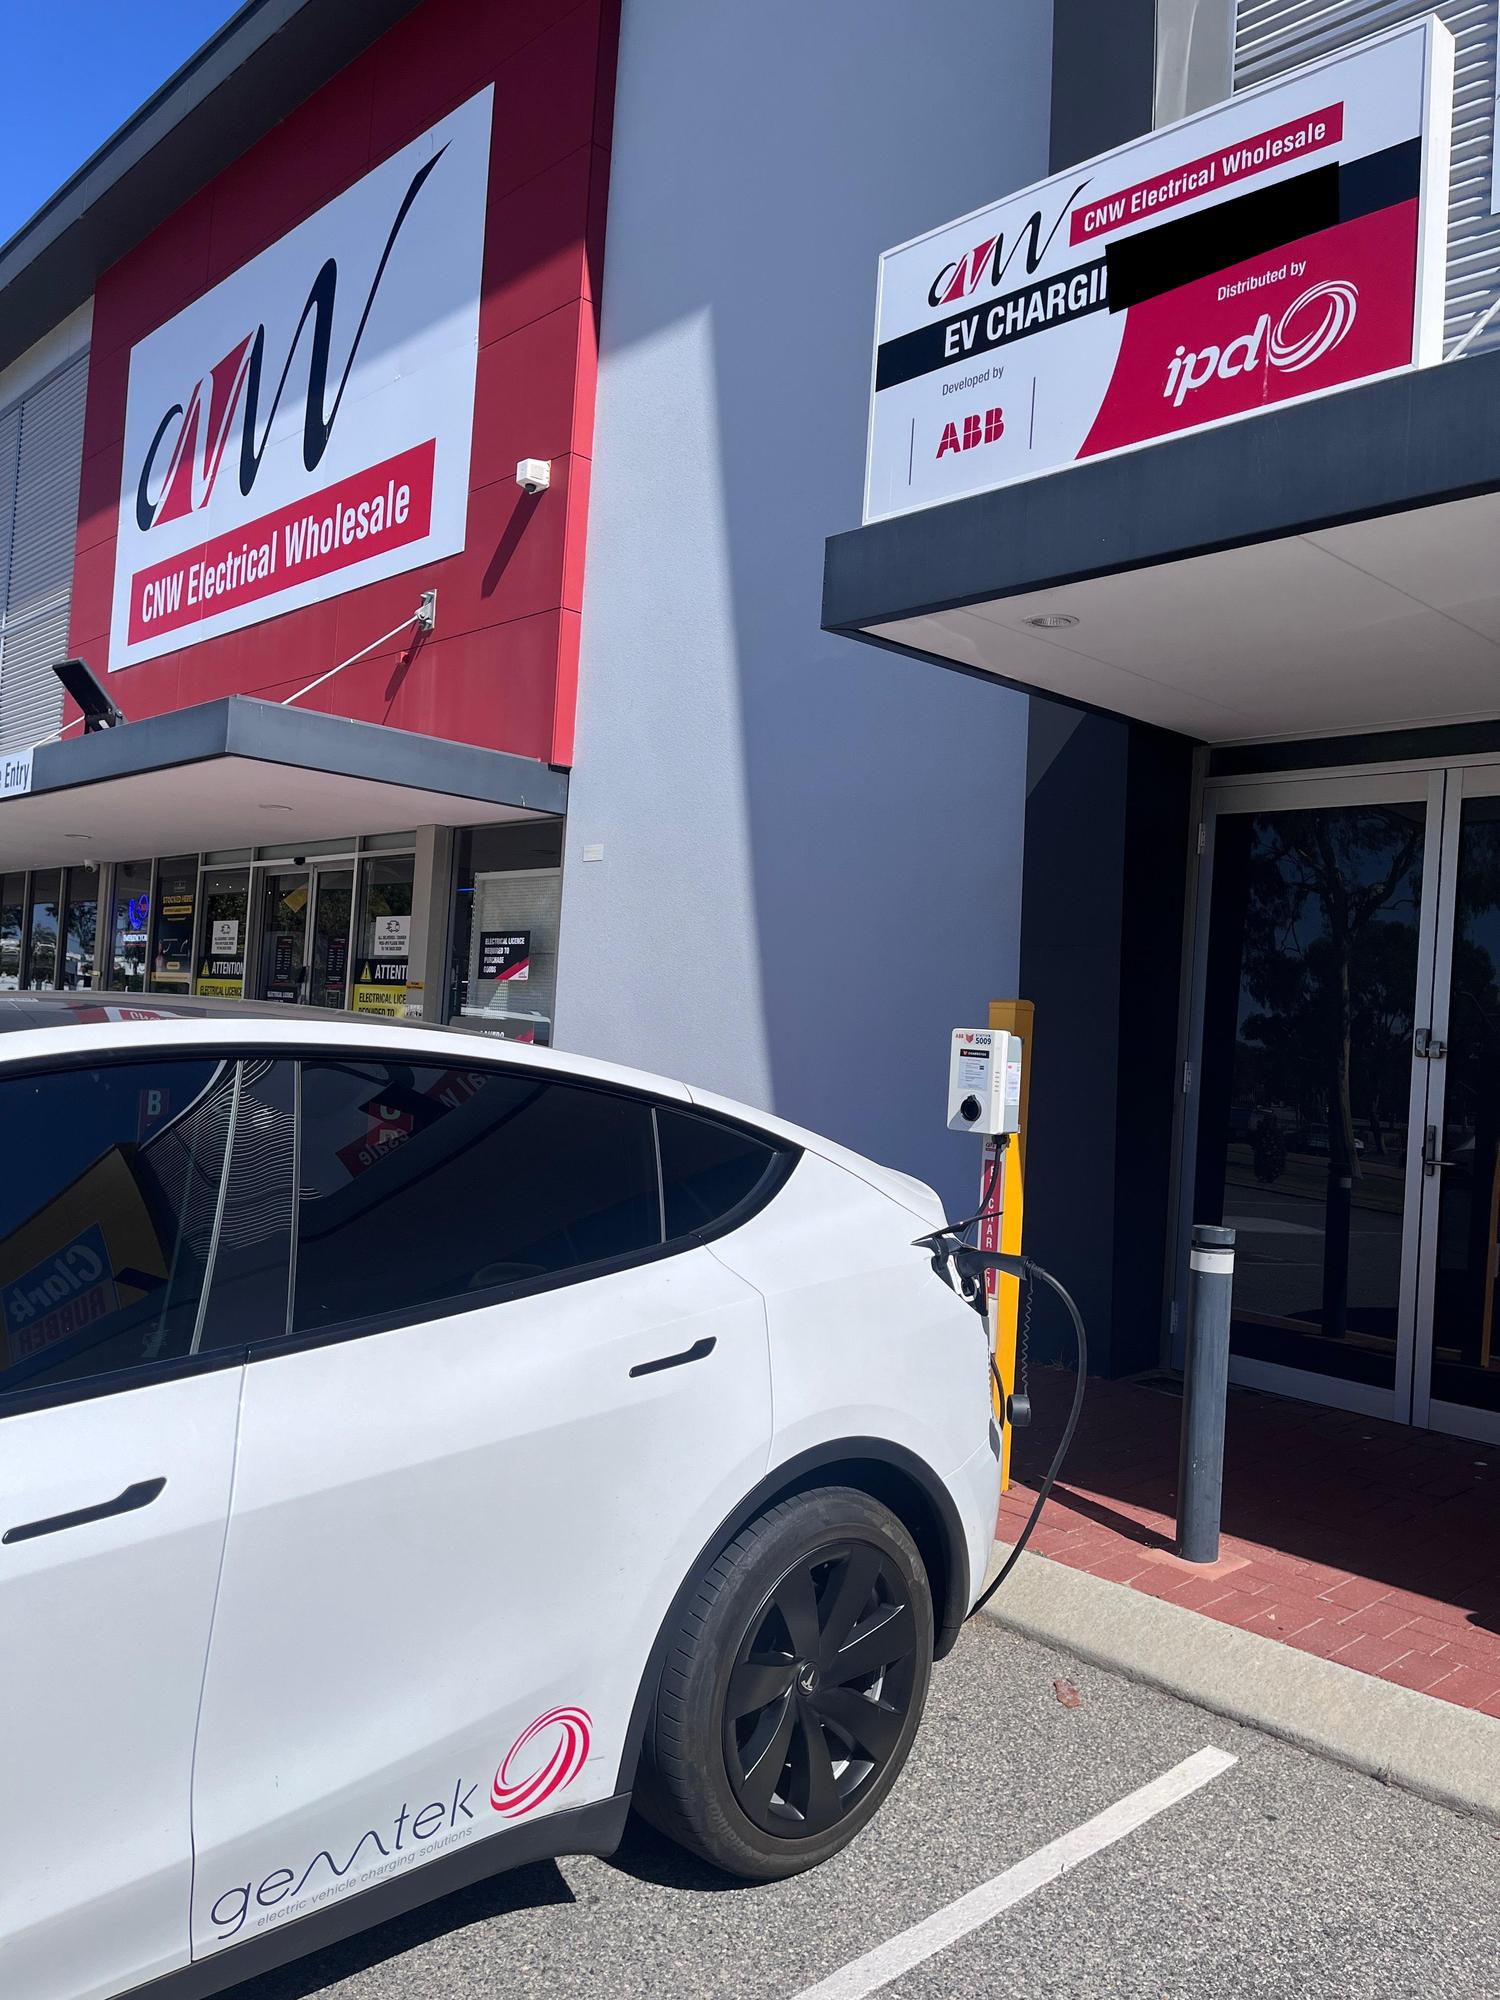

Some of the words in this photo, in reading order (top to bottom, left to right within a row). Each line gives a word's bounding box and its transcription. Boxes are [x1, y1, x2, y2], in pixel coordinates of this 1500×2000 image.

[1083, 199, 1125, 232] CNW
[1130, 162, 1216, 214] Electrical
[1222, 122, 1327, 177] Wholesale
[1217, 265, 1286, 301] Distributed
[1290, 260, 1307, 276] by
[944, 314, 980, 358] EV
[942, 369, 990, 396] Developed
[992, 366, 1005, 380] by
[1163, 313, 1269, 408] ipd
[935, 407, 1004, 459] ABB
[142, 574, 182, 624] CNW
[187, 530, 278, 607] Electrical
[284, 480, 411, 563] Wholesale
[4, 761, 30, 791] Entry
[359, 992, 392, 1004] ELECTRICAL
[975, 1037, 992, 1045] 5009
[257, 1900, 307, 1927] electric
[312, 1877, 356, 1904] vehicle
[360, 1850, 415, 1883] charging
[418, 1825, 473, 1857] solutions
